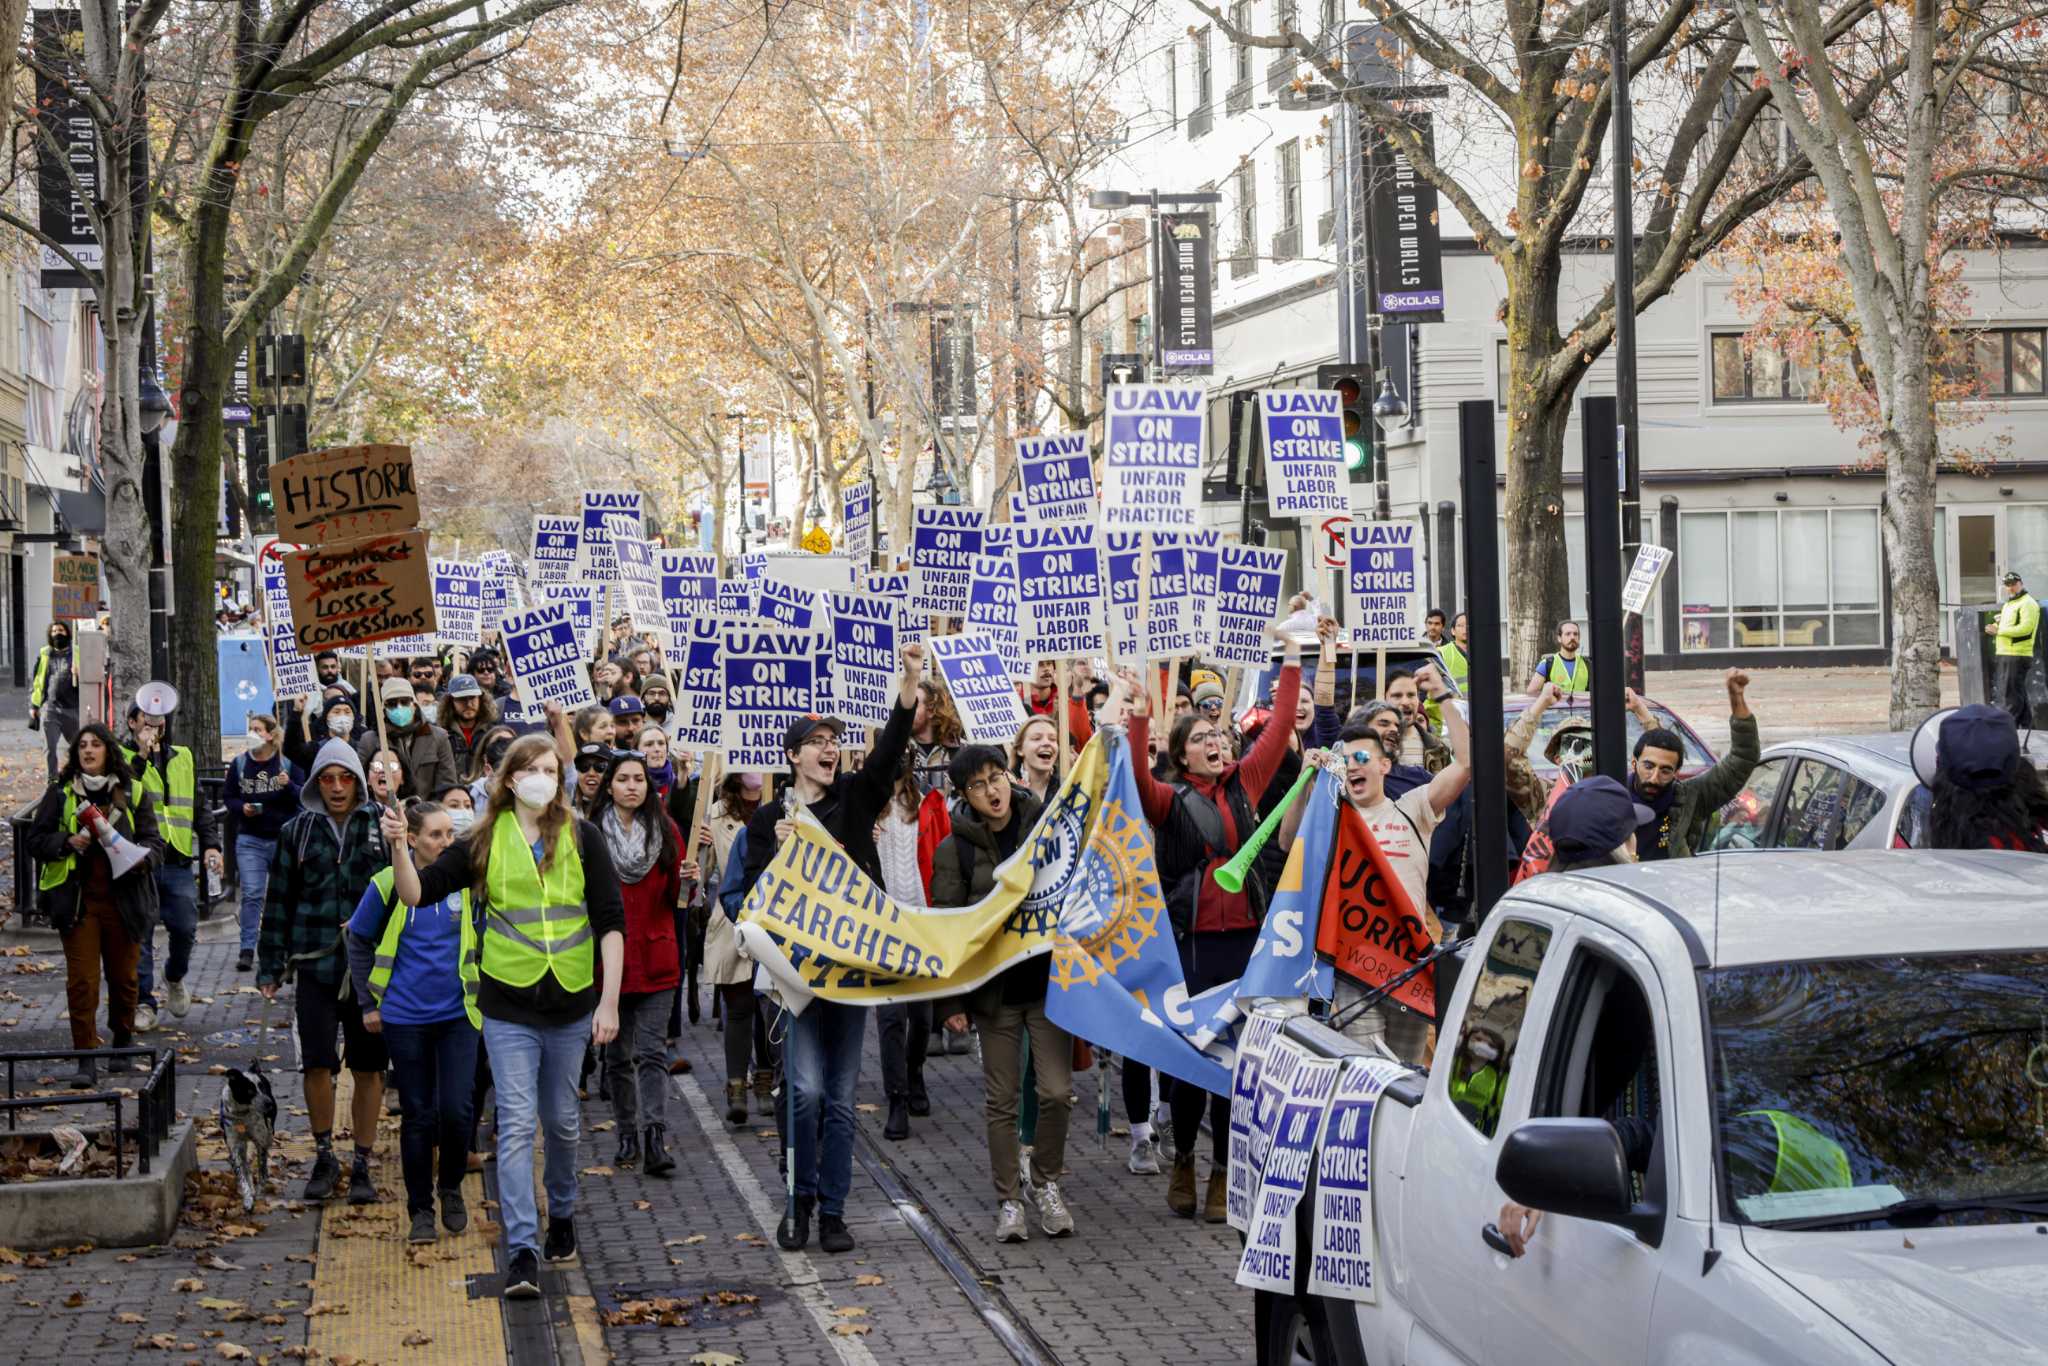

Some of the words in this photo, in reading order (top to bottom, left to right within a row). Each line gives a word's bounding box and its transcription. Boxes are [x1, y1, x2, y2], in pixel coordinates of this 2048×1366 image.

[1397, 195, 1417, 231] OPEN
[1179, 242, 1194, 271] WIDE
[1400, 237, 1420, 286] WALLS
[1180, 275, 1195, 303] OPEN
[1398, 295, 1441, 306] KOLAS
[1180, 308, 1196, 345] WALLS
[1178, 353, 1210, 361] KOLAS
[1114, 389, 1202, 411] UAW
[1266, 394, 1338, 413] UAW
[1138, 418, 1173, 441] ON
[1291, 418, 1320, 437] ON
[1020, 436, 1085, 459] UAW
[1111, 441, 1198, 465] STRIKE
[1273, 439, 1341, 458] STRIKE
[1044, 462, 1070, 480] ON
[1120, 471, 1186, 487] UNFAIR
[1283, 464, 1337, 478] UNFAIR
[845, 484, 870, 502] UAW
[1028, 480, 1093, 506] STRIKE
[1122, 489, 1182, 504] LABOR
[1287, 480, 1336, 494] LABOR
[585, 493, 640, 507] UAW
[1277, 496, 1348, 510] PRACTICE
[917, 508, 984, 528] UAW
[1039, 503, 1088, 519] UNFAIR
[1107, 507, 1195, 524] PRACTICE
[539, 520, 579, 532] UAW
[1351, 526, 1413, 545] UAW
[548, 535, 566, 546] ON
[936, 532, 961, 548] ON
[1016, 524, 1094, 548] UAW
[535, 547, 576, 559] STRIKE
[1221, 547, 1283, 570] UAW
[1369, 550, 1394, 569] ON
[436, 562, 480, 578] UAW
[538, 562, 569, 571] UNFAIR
[662, 557, 716, 574] UAW
[1042, 553, 1073, 574] ON
[539, 571, 567, 580] LABOR
[922, 569, 971, 585] UNFAIR
[1236, 574, 1263, 593] ON
[1351, 571, 1414, 592] STRIKE
[450, 581, 468, 594] ON
[547, 586, 591, 598] UAW
[680, 580, 701, 597] ON
[763, 579, 815, 606] UAW
[923, 584, 967, 598] LABOR
[1022, 574, 1097, 598] STRIKE
[436, 593, 480, 609] STRIKE
[664, 598, 717, 617] STRIKE
[721, 597, 738, 609] ON
[834, 594, 892, 620] UAW
[1033, 601, 1091, 619] UNFAIR
[1217, 591, 1276, 616] STRIKE
[1360, 596, 1407, 610] UNFAIR
[441, 609, 475, 621] UNFAIR
[502, 603, 565, 634] UAW
[774, 603, 796, 621] ON
[1363, 611, 1405, 625] LABOR
[443, 620, 473, 631] LABOR
[1036, 618, 1090, 636] LABOR
[1220, 615, 1266, 632] UNFAIR
[435, 630, 480, 642] PRACTICE
[528, 630, 554, 650] ON
[852, 623, 876, 645] ON
[1220, 631, 1261, 648] LABOR
[1353, 627, 1415, 642] PRACTICE
[279, 639, 297, 652] ON
[387, 643, 432, 653] PRACTICE
[725, 634, 811, 655] UAW
[933, 636, 991, 656] UAW
[1025, 634, 1103, 654] PRACTICE
[515, 642, 577, 674] STRIKE
[837, 641, 893, 669] STRIKE
[277, 664, 309, 677] UNFAIR
[752, 662, 786, 683] ON
[960, 658, 987, 675] ON
[280, 674, 310, 687] LABOR
[528, 665, 576, 688] UNFAIR
[844, 669, 888, 689] UNFAIR
[951, 674, 1011, 695] STRIKE
[276, 682, 317, 697] PRACTICE
[534, 679, 577, 700] LABOR
[728, 685, 810, 708] STRIKE
[847, 685, 886, 705] LABOR
[966, 696, 1012, 712] UNFAIR
[974, 710, 1016, 725] LABOR
[1339, 848, 1389, 908] UC
[1265, 1044, 1300, 1082] UAW
[1242, 1060, 1256, 1091] ON
[1290, 1065, 1337, 1099] UAW
[1340, 1063, 1381, 1094] UAW
[1231, 1093, 1254, 1129] STRIKE
[1287, 1110, 1310, 1144] ON
[1338, 1106, 1360, 1141] ON
[1267, 1146, 1310, 1184] STRIKE
[1320, 1145, 1367, 1184] STRIKE
[1323, 1193, 1362, 1223] UNFAIR
[1323, 1224, 1361, 1255] LABOR
[1245, 1247, 1291, 1282] PRACTICE
[1315, 1254, 1371, 1289] PRACTICE
